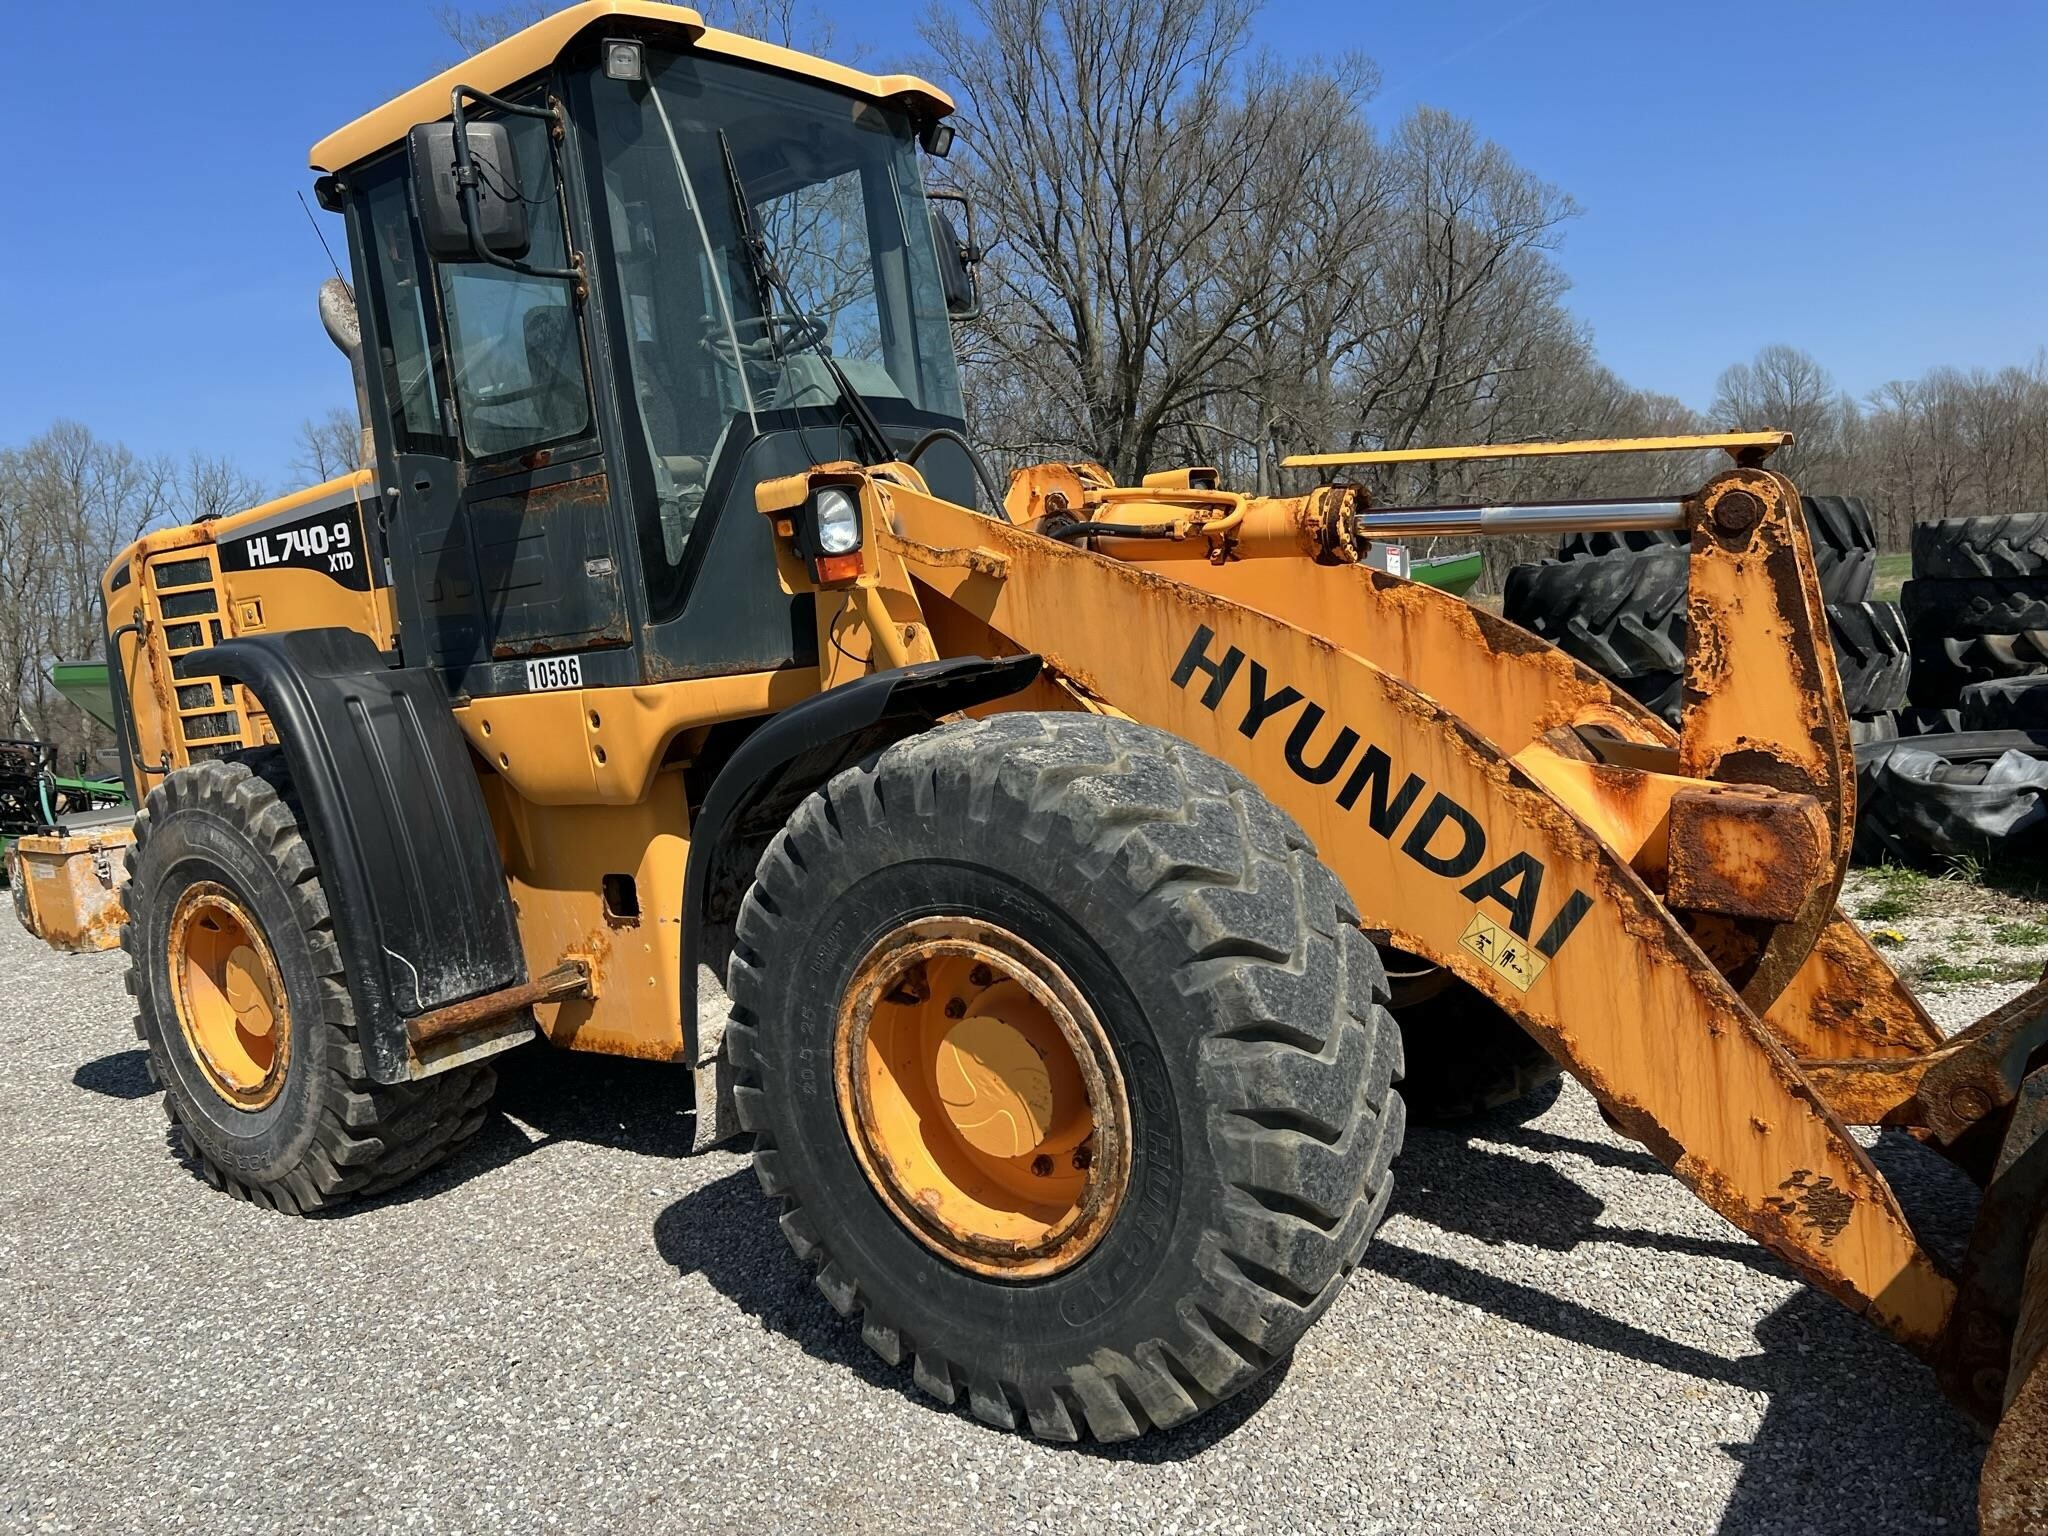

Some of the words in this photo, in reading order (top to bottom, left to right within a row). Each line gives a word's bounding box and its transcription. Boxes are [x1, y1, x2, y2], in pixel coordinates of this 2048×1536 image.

[328, 551, 354, 573] XTD
[529, 658, 579, 688] 10586
[1170, 623, 1595, 959] HYUNDAI
